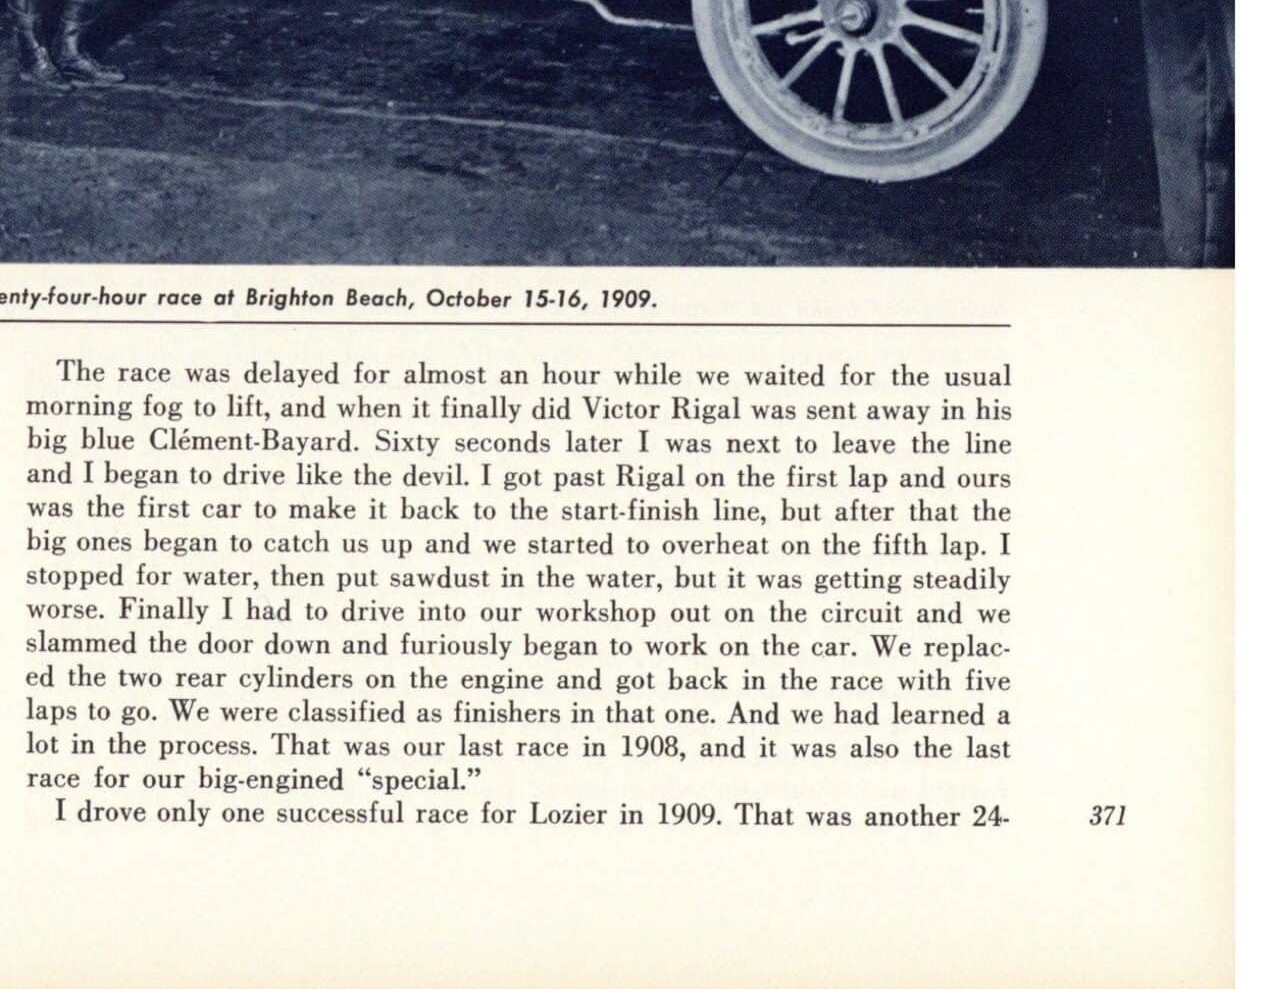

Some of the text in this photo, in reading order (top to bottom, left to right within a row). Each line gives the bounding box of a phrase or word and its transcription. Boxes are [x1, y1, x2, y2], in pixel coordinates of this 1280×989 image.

[156, 292, 203, 307] race
[212, 288, 236, 307] at
[245, 285, 335, 312] Brighton
[345, 286, 415, 311] Beach,
[425, 287, 513, 309] October
[524, 288, 589, 312] 15-16,
[601, 288, 658, 310] 1909.
[54, 358, 1012, 389] The race was delayed for almost an hour while we waited for the usual
[27, 425, 1013, 458] big blue Clément-Bayard. Sixty seconds later I was next to leave the line
[25, 595, 1012, 629] worse. Finally I had to drive into our workshop out on the circuit and we
[27, 772, 81, 789] race
[93, 764, 131, 790] for
[141, 773, 186, 790] our
[198, 764, 345, 795] big-engined
[54, 797, 1011, 829] I drove only one successful race for Lozier in 1909. That was another 24-
[1088, 804, 1127, 827] 371
